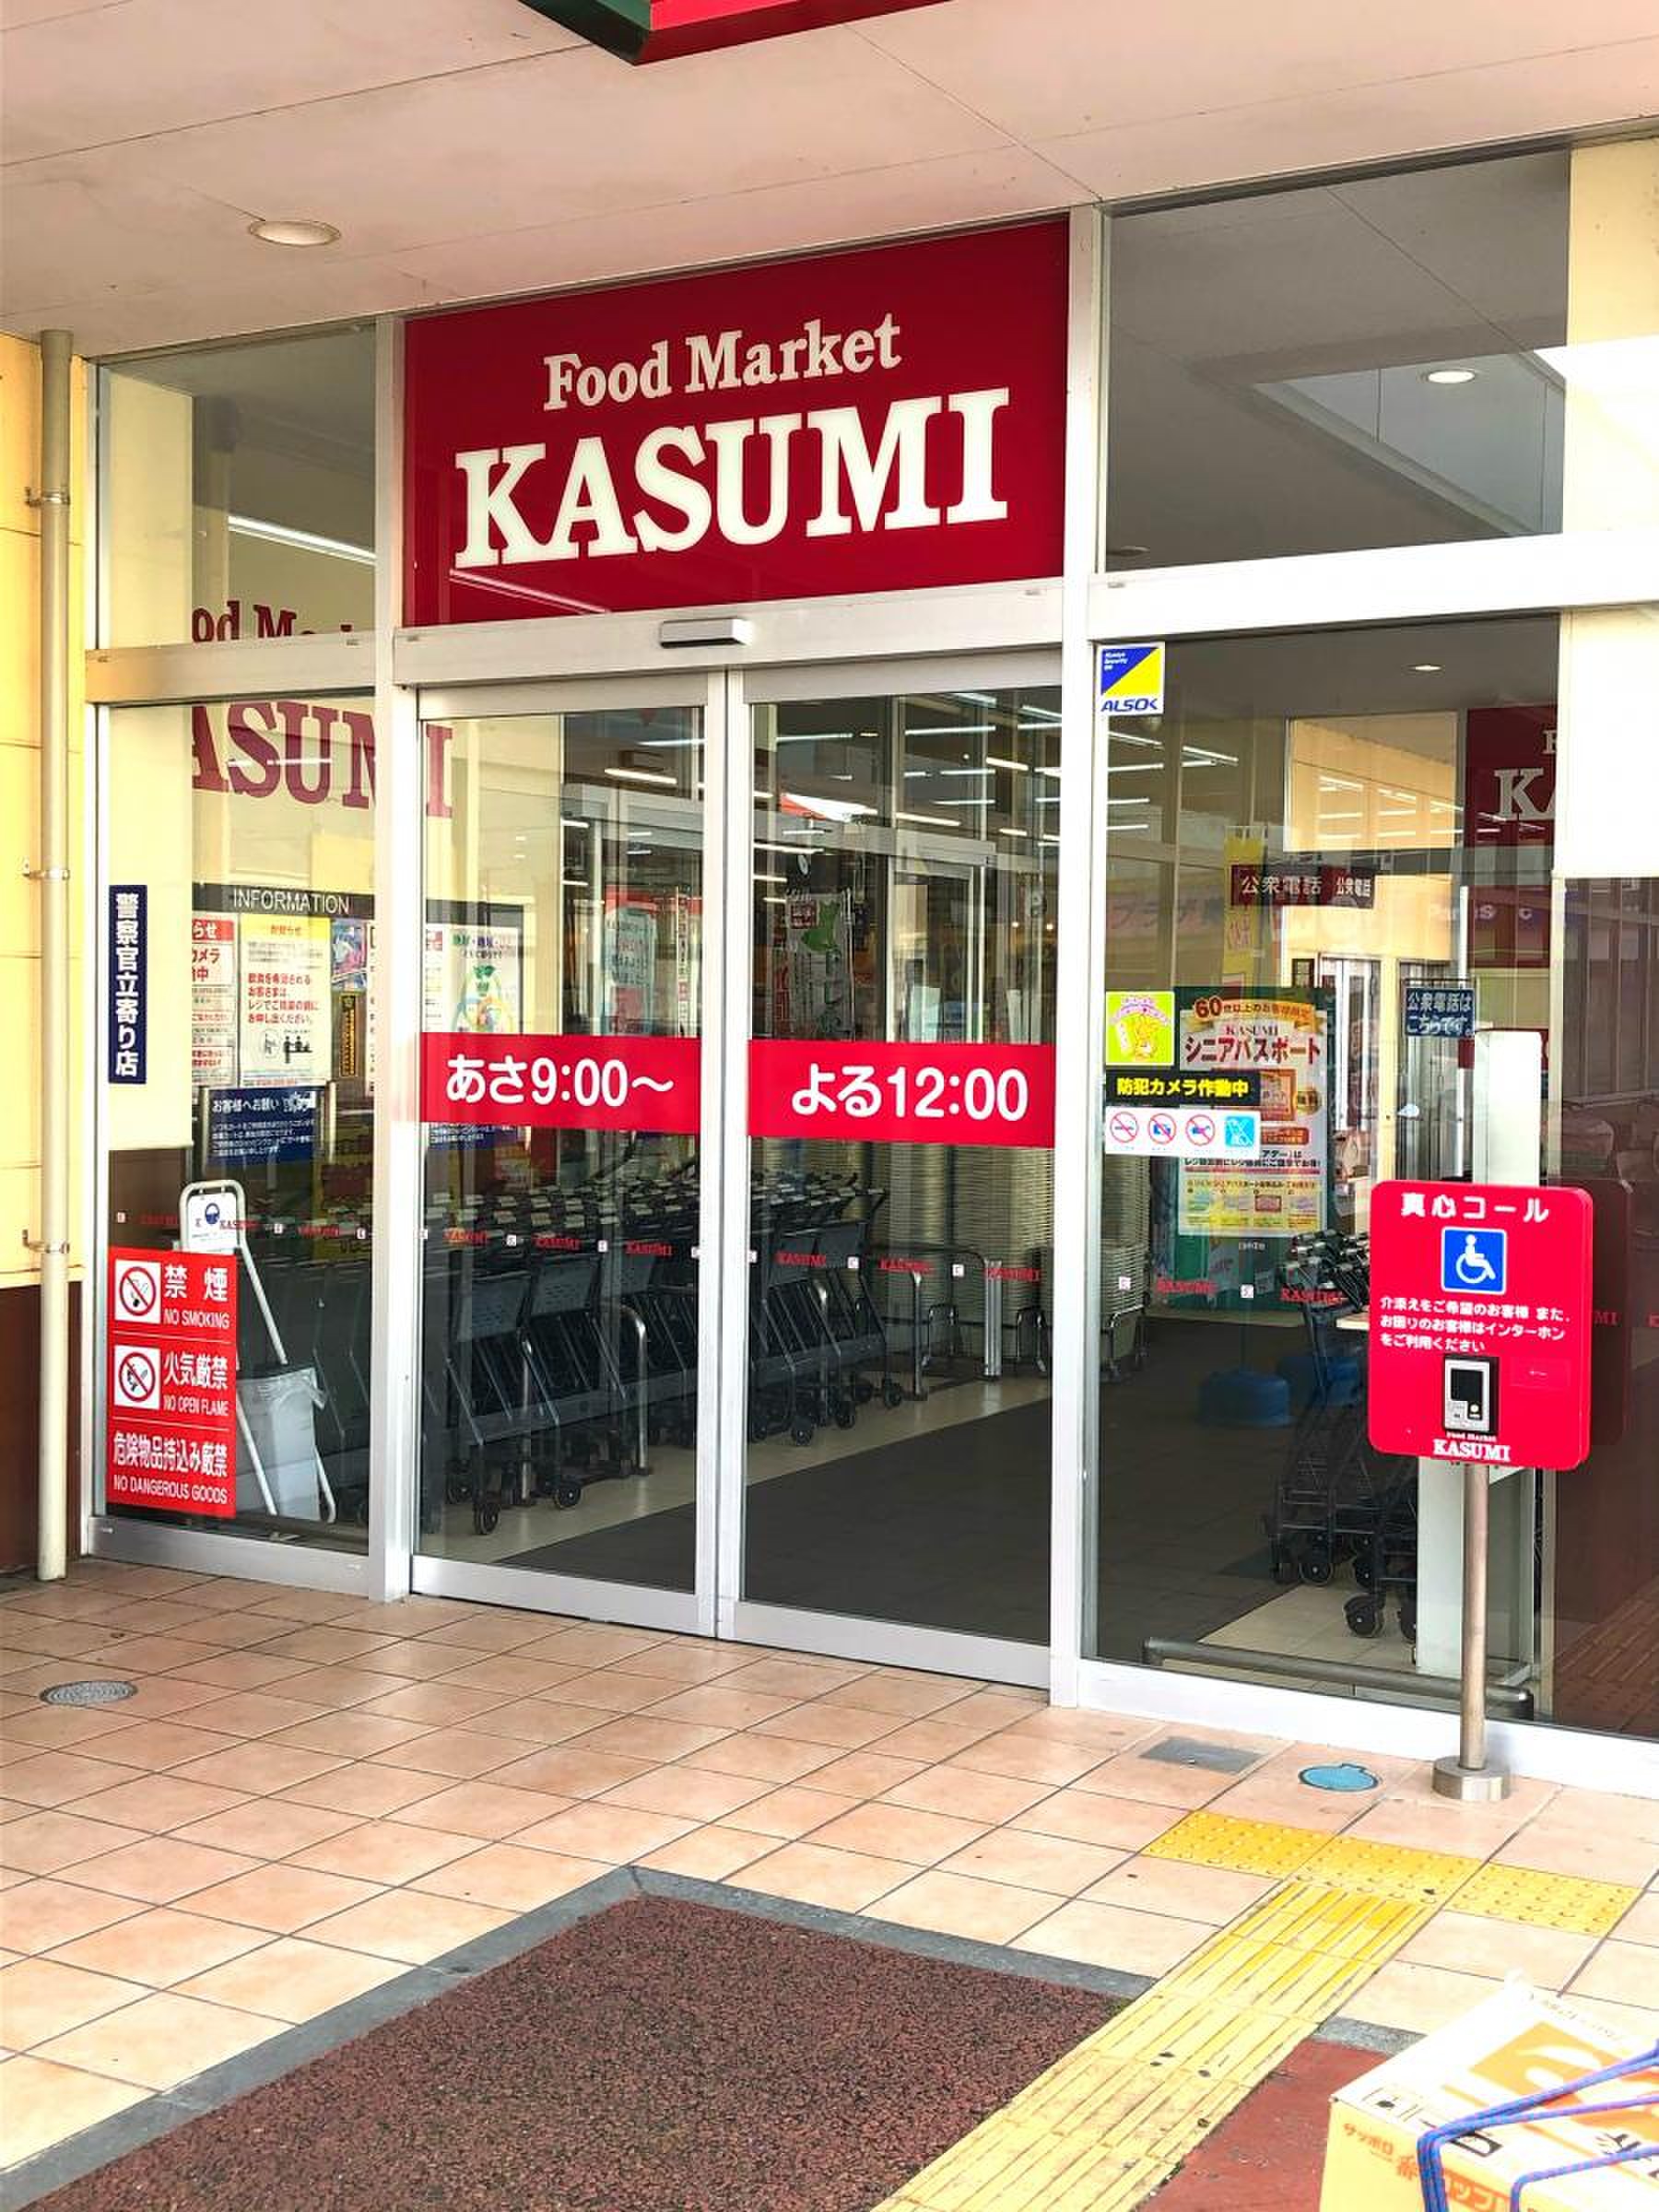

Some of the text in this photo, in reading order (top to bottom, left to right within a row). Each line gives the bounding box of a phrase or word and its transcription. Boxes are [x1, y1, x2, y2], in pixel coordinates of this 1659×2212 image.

[544, 313, 901, 411] Food Market
[454, 387, 1009, 571] KASUMI
[1100, 698, 1158, 712] ALSOK
[1241, 877, 1323, 895] 公衆電話
[233, 888, 350, 914] INFORMATION
[115, 892, 139, 1077] 警察官立寄り店
[1408, 992, 1472, 1013] 公衆電話は
[1185, 1036, 1321, 1065] シニアパスポート
[791, 1063, 1030, 1121] よる12:00
[1116, 1077, 1249, 1098] 防犯カメラ作動中
[1401, 1192, 1549, 1223] 真心コール
[164, 1309, 229, 1329] NO SMOKING
[1380, 1315, 1566, 1340] お困りのお客様はインターホン
[1380, 1333, 1486, 1353] をご利用ください
[164, 1351, 229, 1390] 火気厳禁
[163, 1395, 229, 1418] NO OPEN FLAME
[112, 1430, 229, 1477] 危険物品持込み厳禁
[1432, 1438, 1511, 1463] KASUMI
[113, 1474, 228, 1504] NO DANGEROUS GOODS
